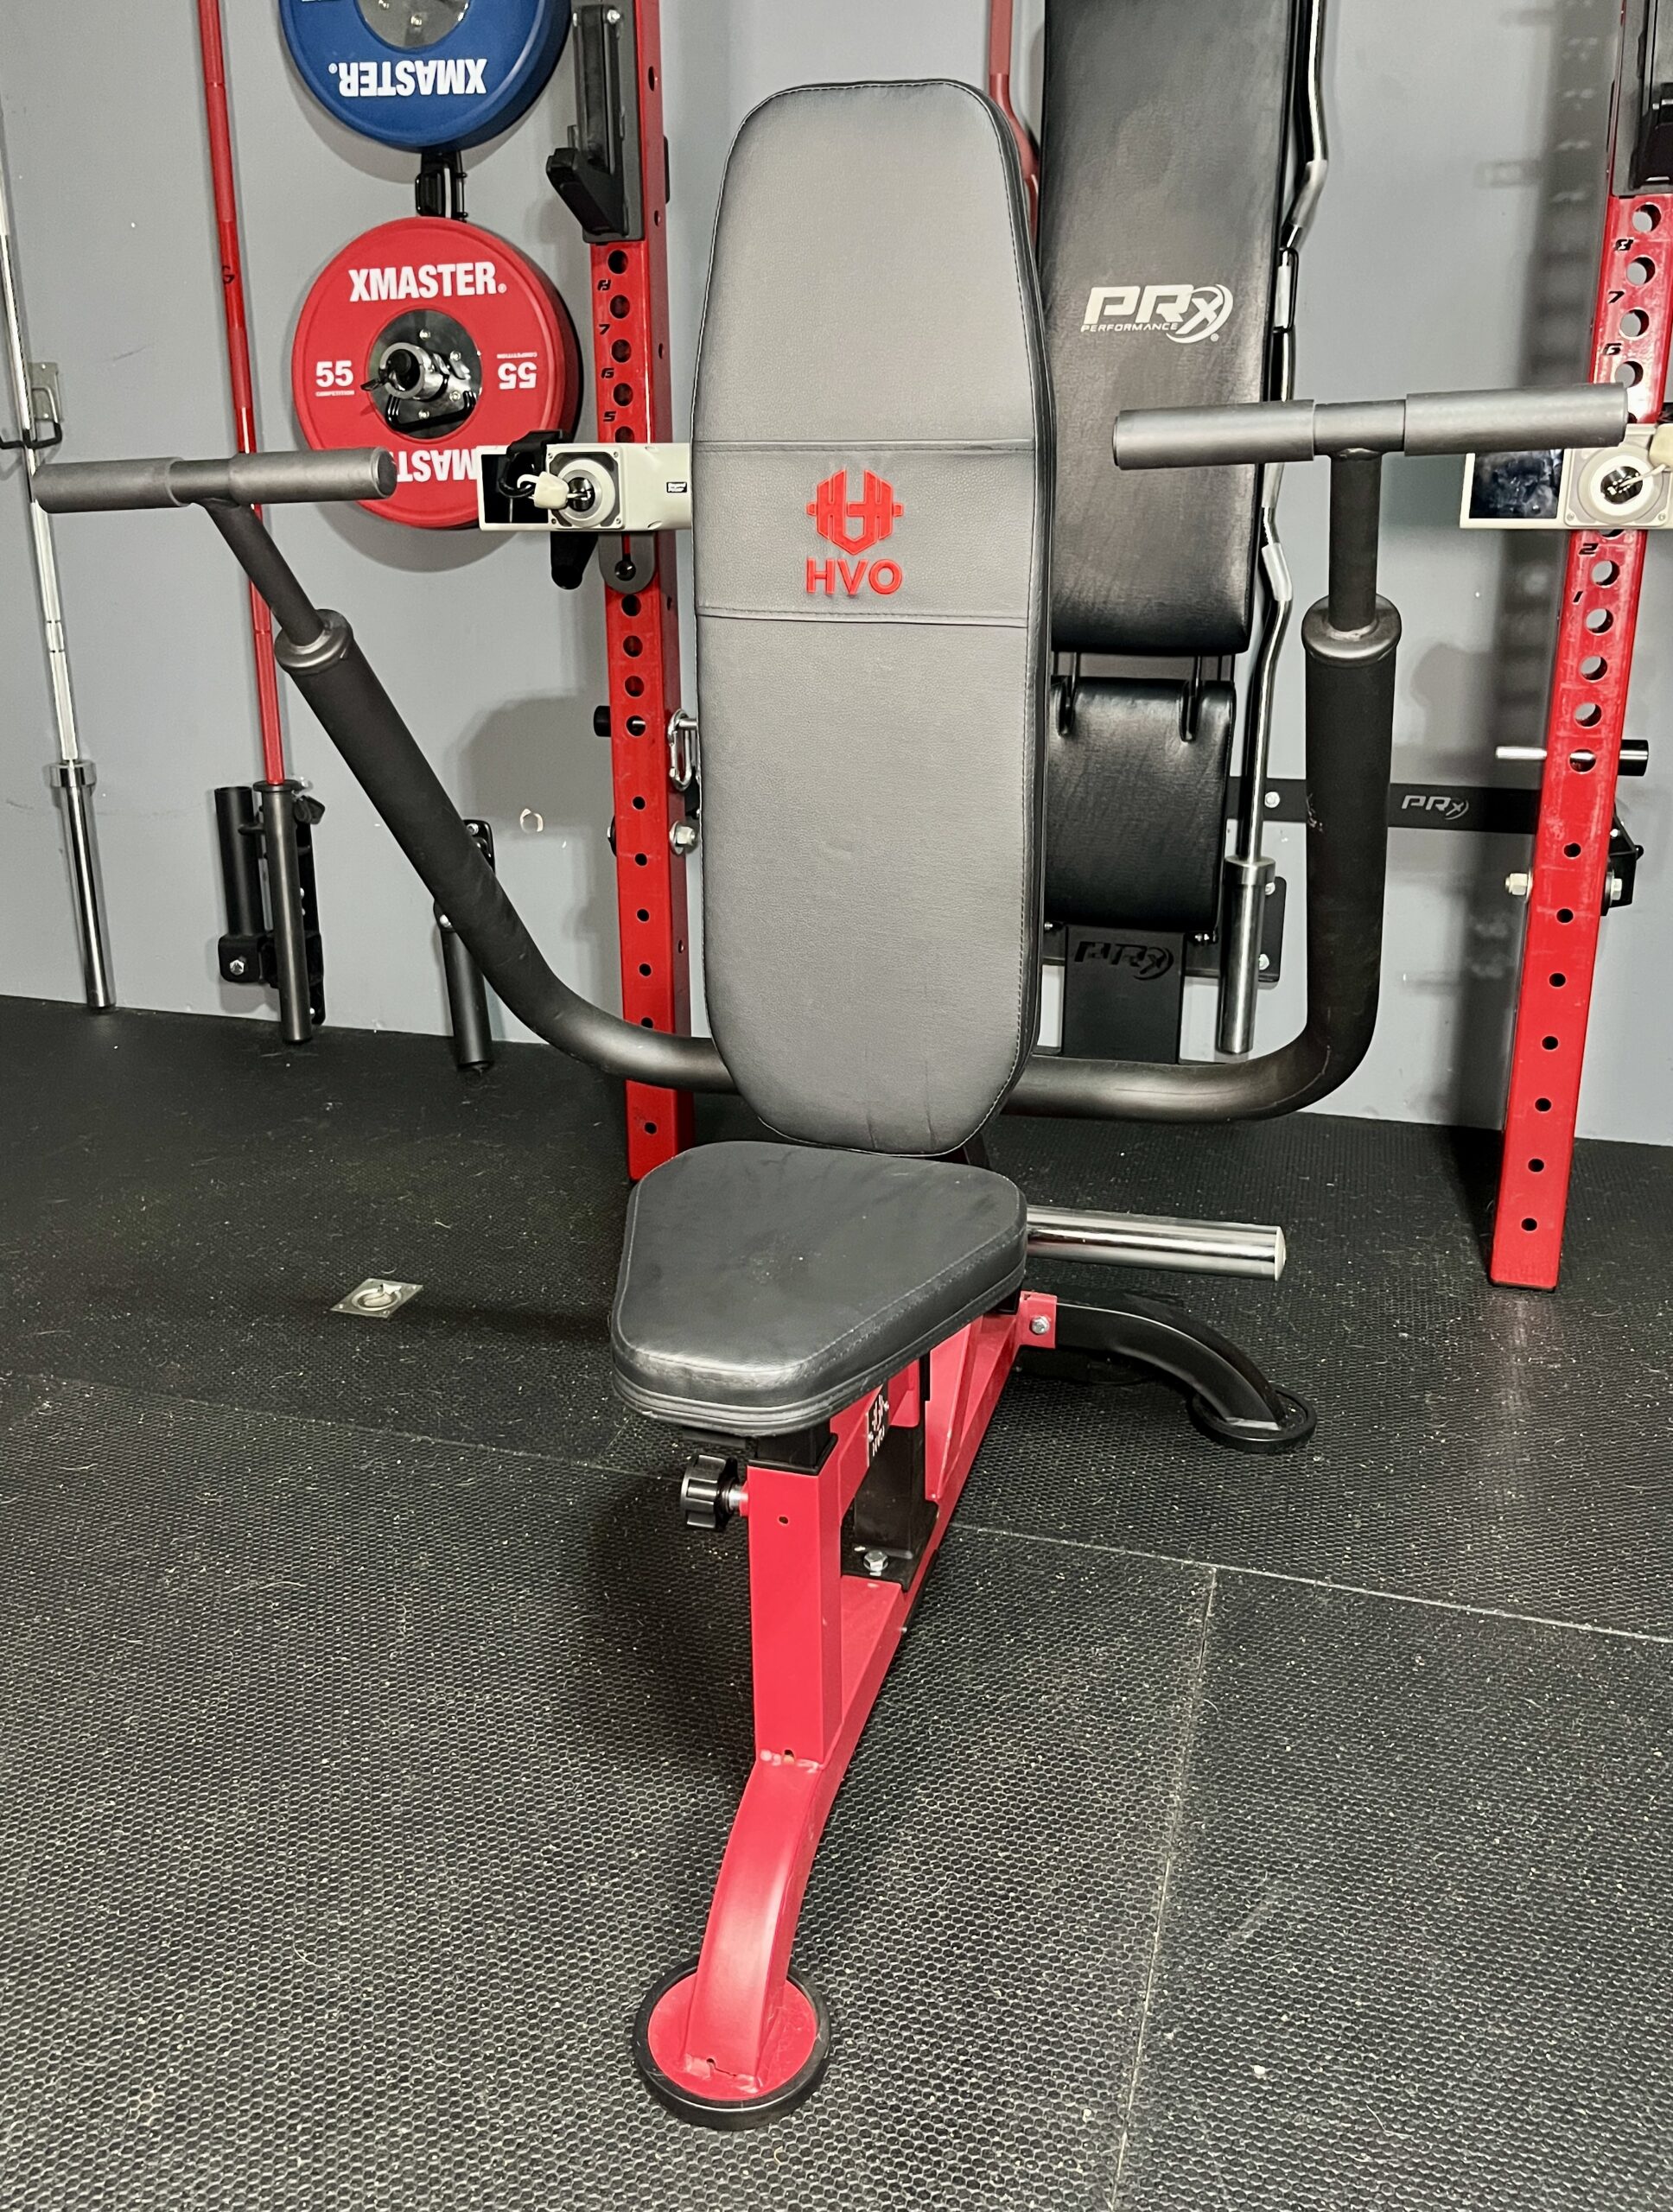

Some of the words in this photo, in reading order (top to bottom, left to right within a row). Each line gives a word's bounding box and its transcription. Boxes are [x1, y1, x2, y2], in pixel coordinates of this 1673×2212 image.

[339, 59, 487, 97] XMASTER
[348, 262, 497, 302] XMASTER
[598, 280, 611, 290] 8
[1608, 291, 1625, 302] 7
[599, 324, 610, 334] 7
[1080, 322, 1178, 333] PERFORMANCE
[315, 360, 354, 387] 55
[498, 362, 538, 389] 55
[601, 368, 614, 378] 6
[603, 411, 616, 422] 5
[1579, 543, 1599, 555] 2
[806, 557, 902, 595] HVO
